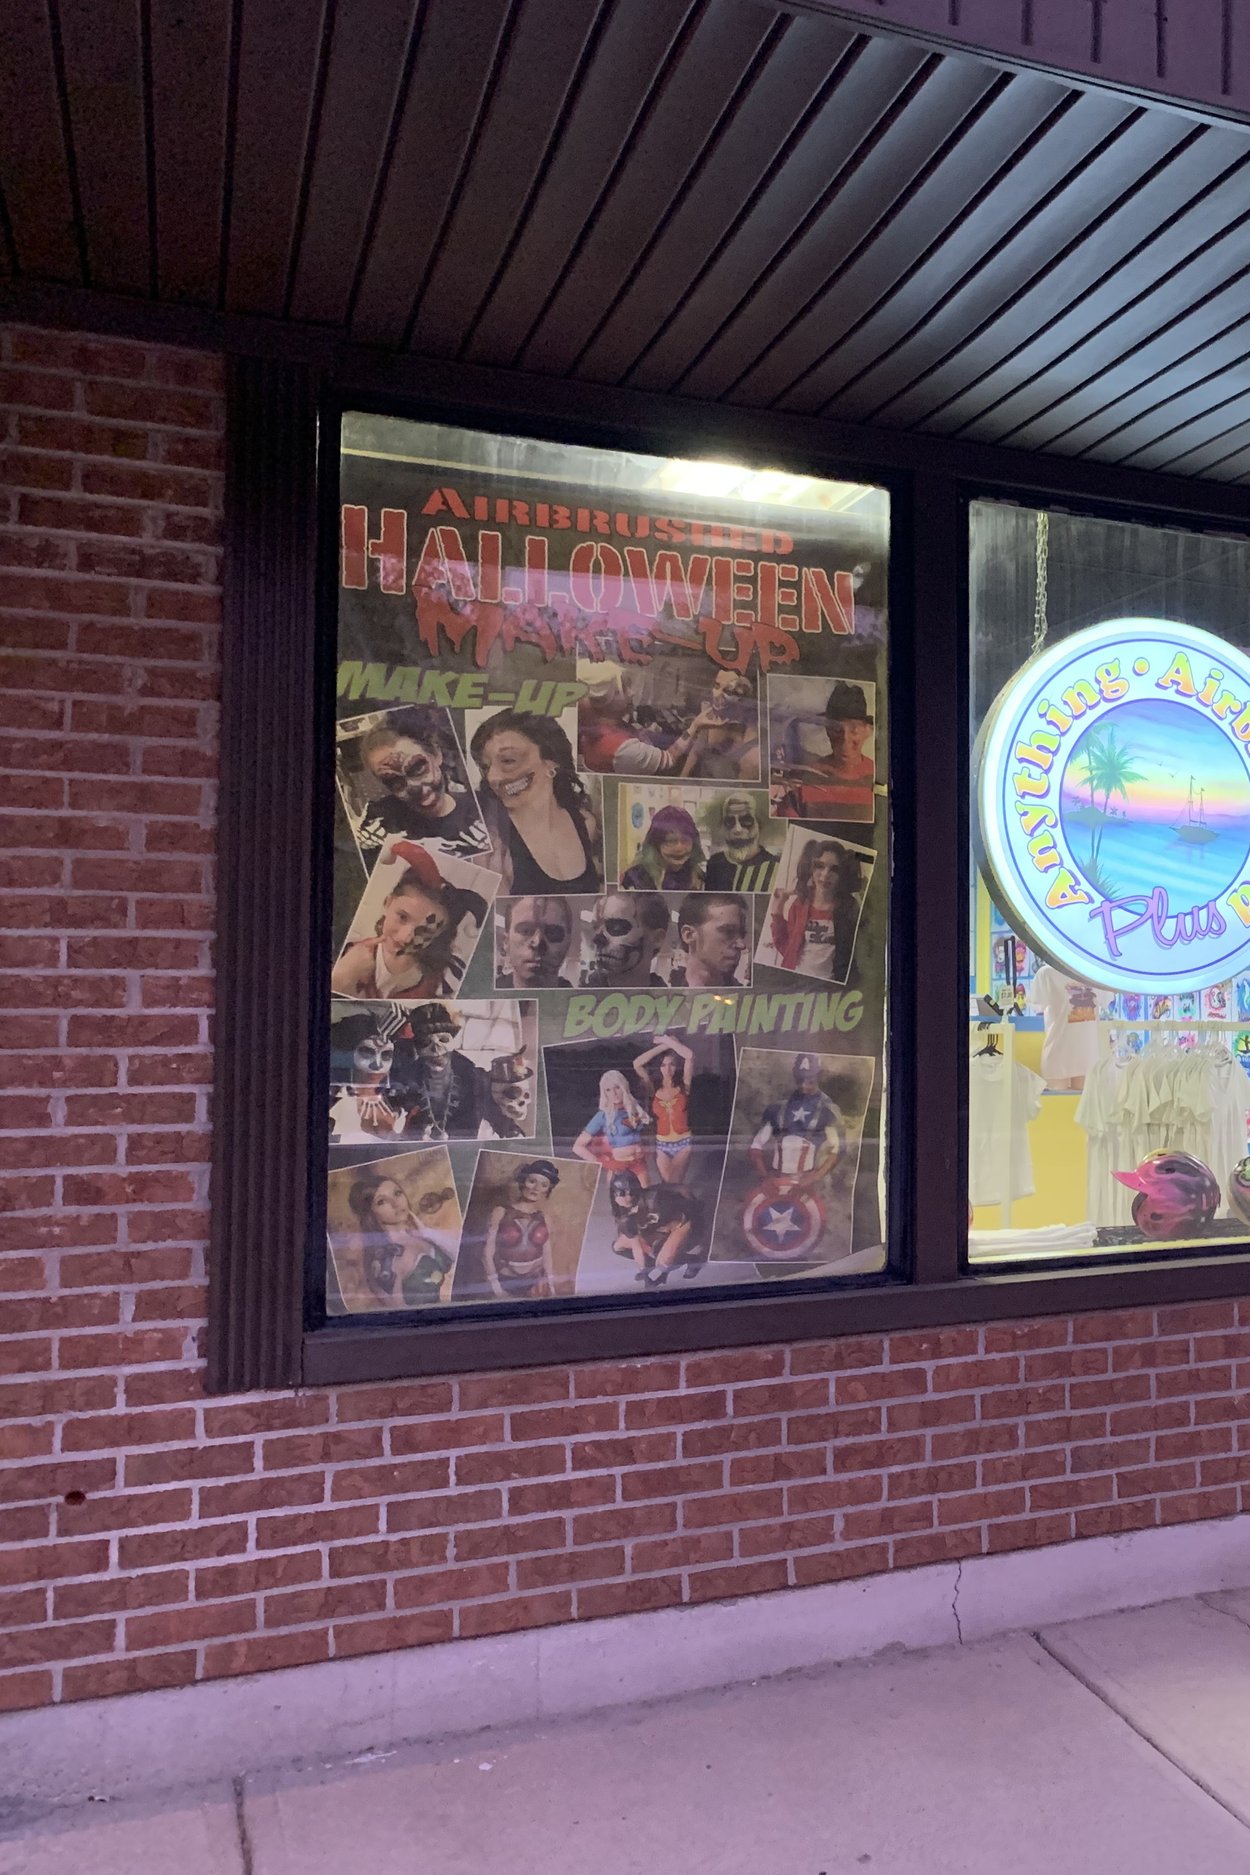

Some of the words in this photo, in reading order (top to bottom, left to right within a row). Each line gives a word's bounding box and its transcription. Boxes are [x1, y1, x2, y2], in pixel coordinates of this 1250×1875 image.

[422, 488, 795, 555] AIRBRUSHED
[341, 504, 856, 635] HALLOWEEN
[337, 660, 590, 718] MAKE-UP
[1013, 658, 1131, 910] Anything
[1089, 886, 1228, 957] Plus
[563, 991, 687, 1038] BODY
[686, 989, 864, 1035] PAINTING
